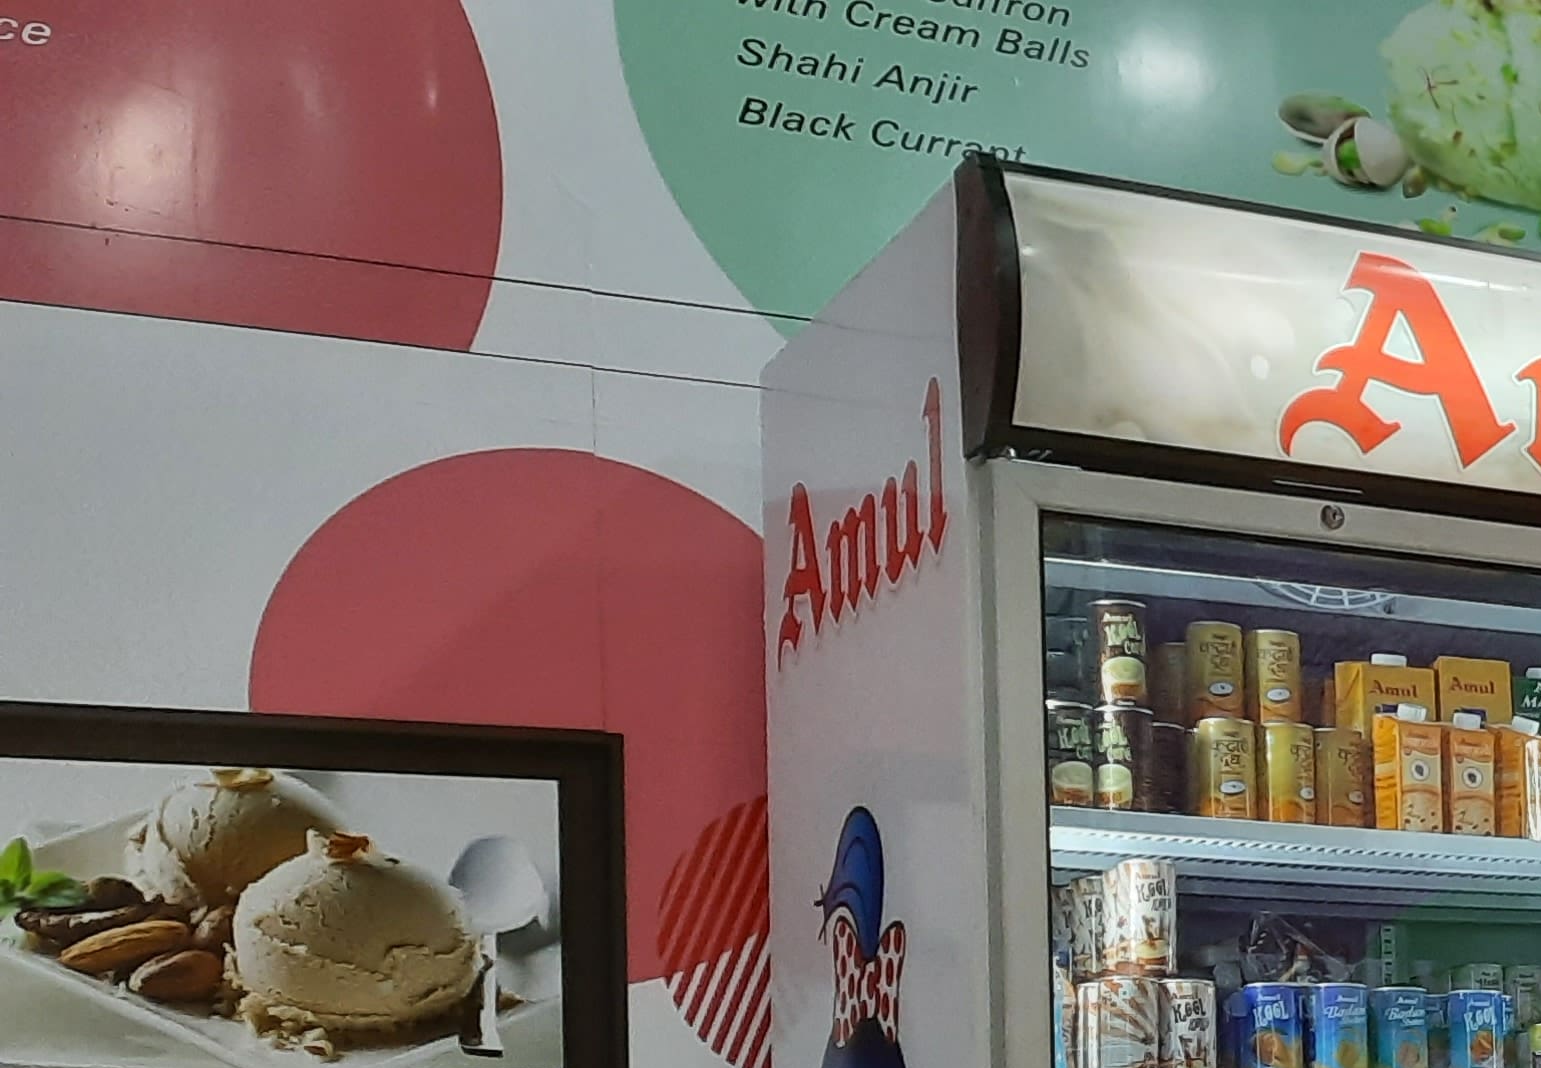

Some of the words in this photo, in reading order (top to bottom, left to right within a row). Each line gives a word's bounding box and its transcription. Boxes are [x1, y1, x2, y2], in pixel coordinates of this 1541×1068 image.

[845, 0, 981, 48] Cream
[995, 28, 1090, 68] Balls
[736, 37, 865, 84] Shahi
[873, 64, 979, 104] Anjir
[737, 96, 856, 141] Black
[775, 376, 950, 672] Amul
[1369, 679, 1419, 699] Amul
[1449, 675, 1496, 696] Amul
